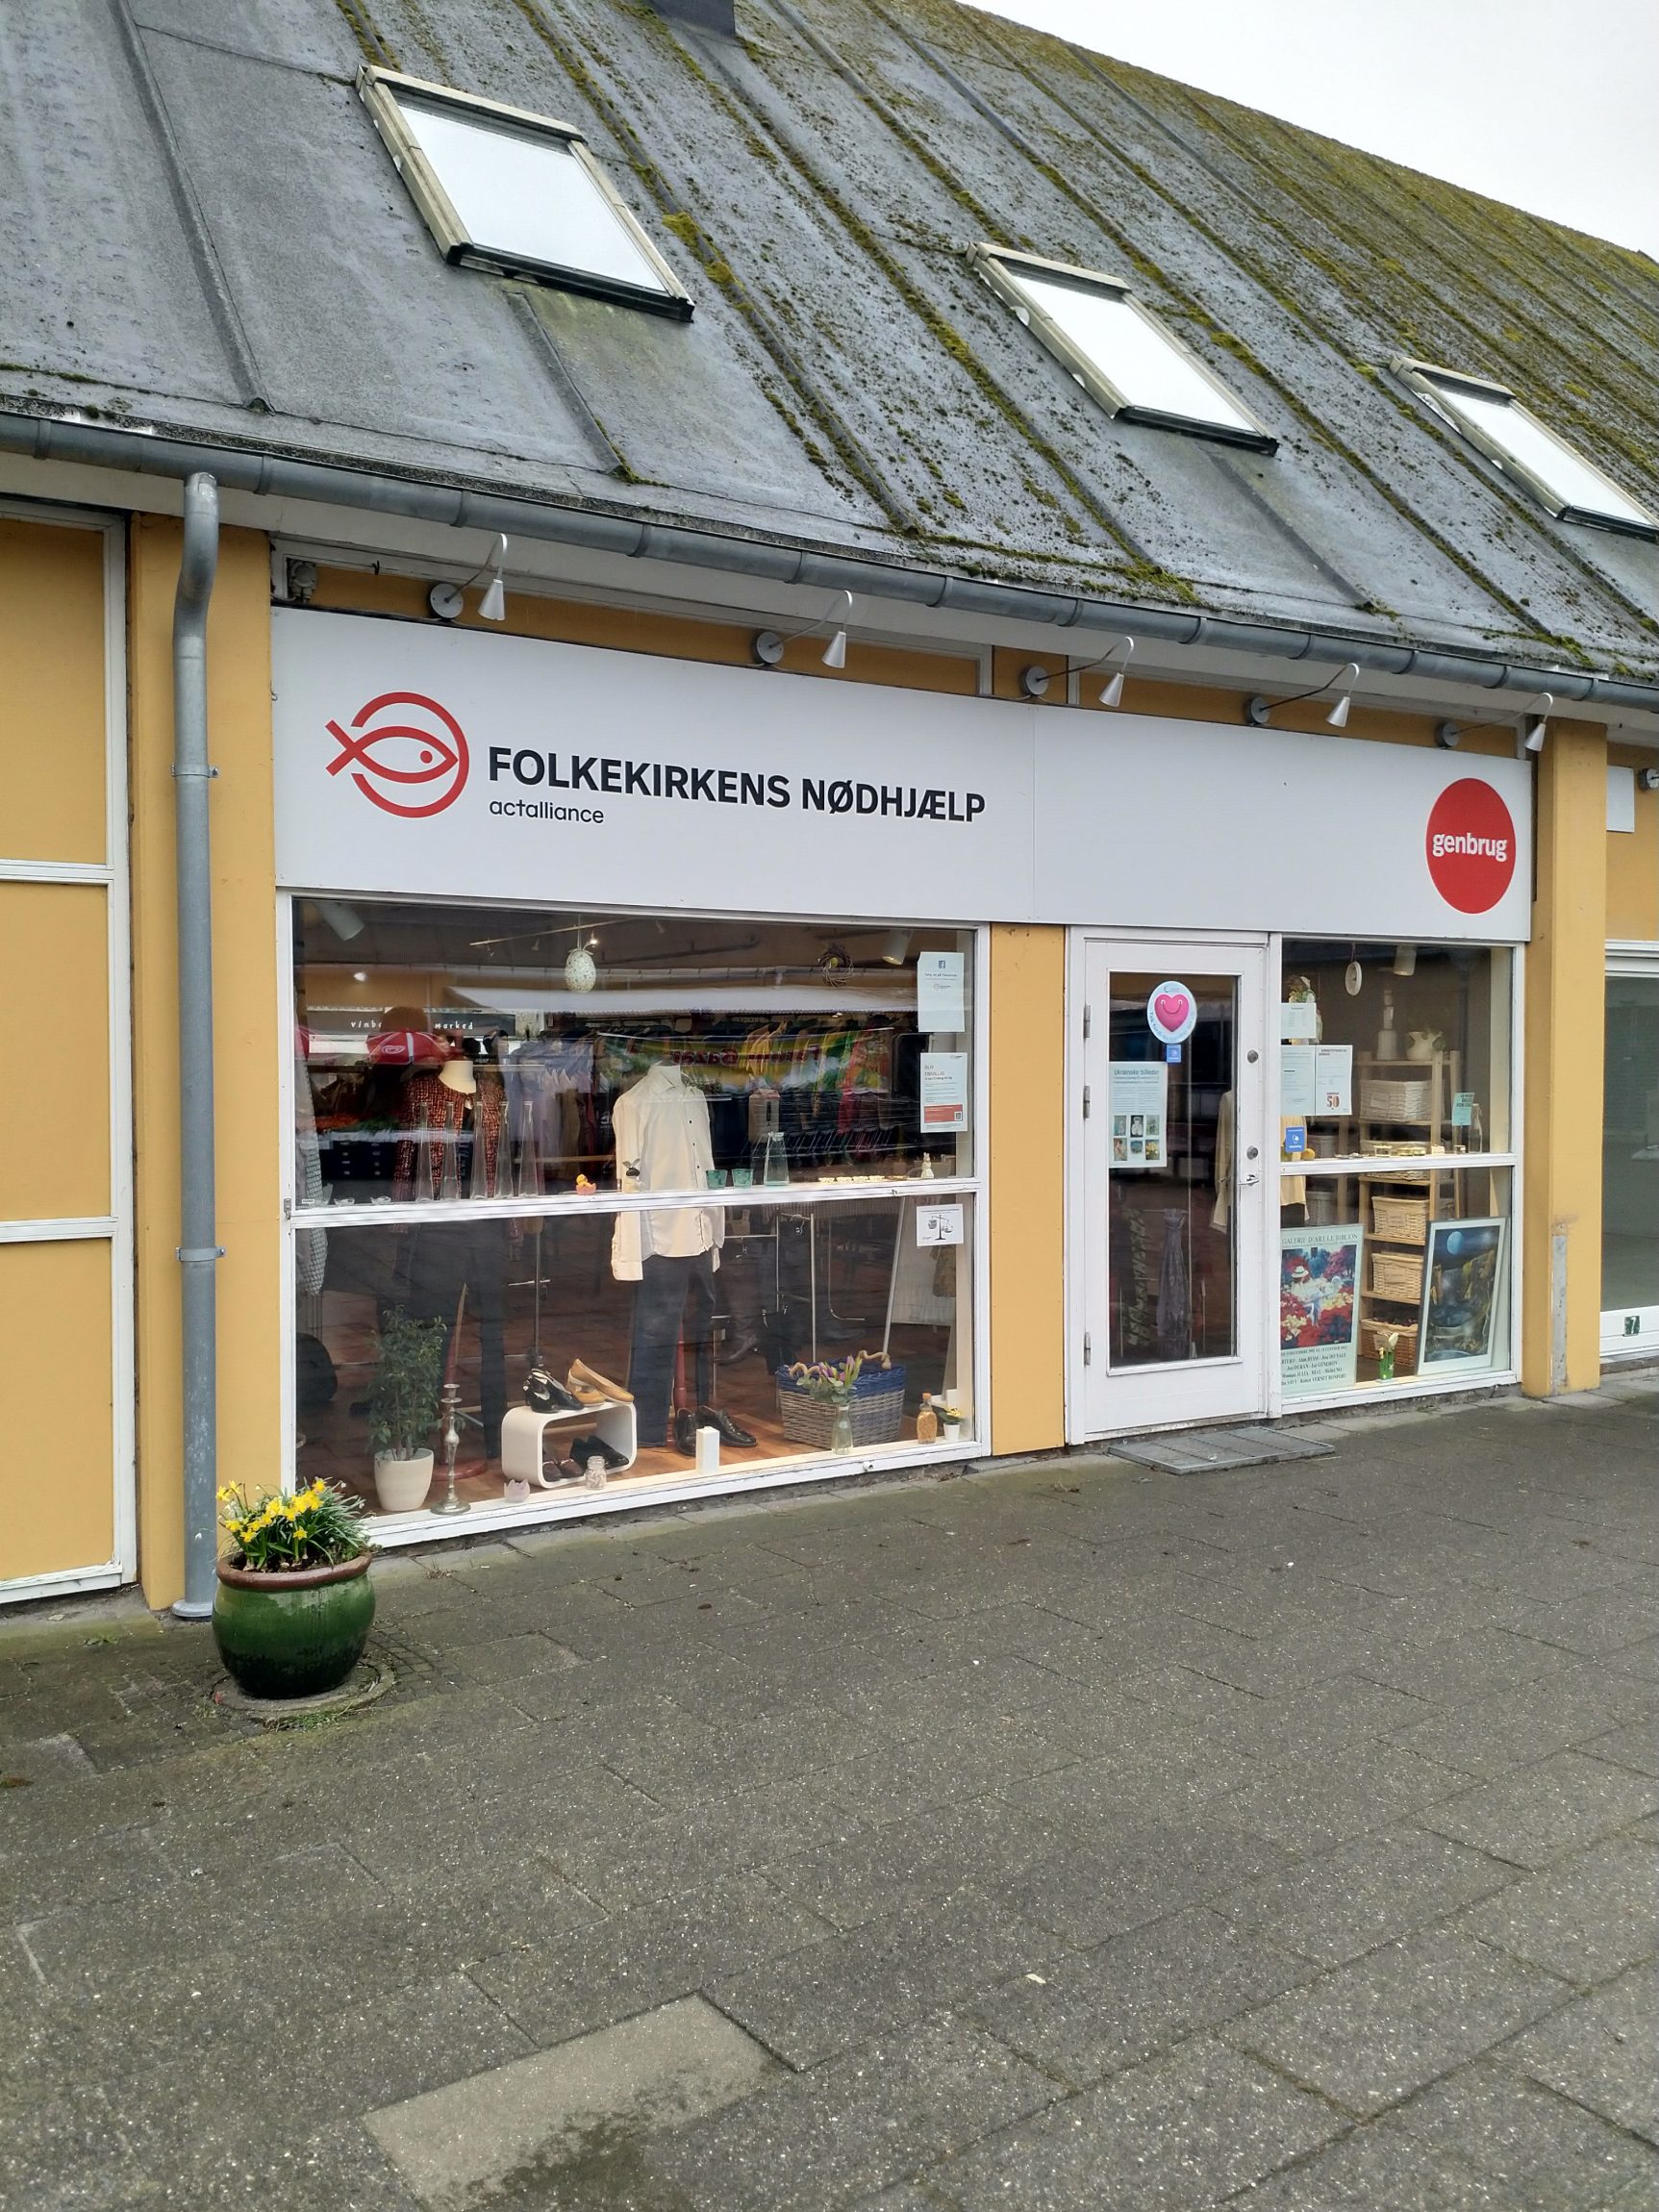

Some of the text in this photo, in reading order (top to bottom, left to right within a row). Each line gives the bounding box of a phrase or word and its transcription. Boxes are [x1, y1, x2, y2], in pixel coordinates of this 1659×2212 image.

[488, 745, 986, 823] FOLKEKIRKENS NØDHJÆLP
[489, 796, 604, 824] actalliance
[1432, 833, 1507, 862] genbrug
